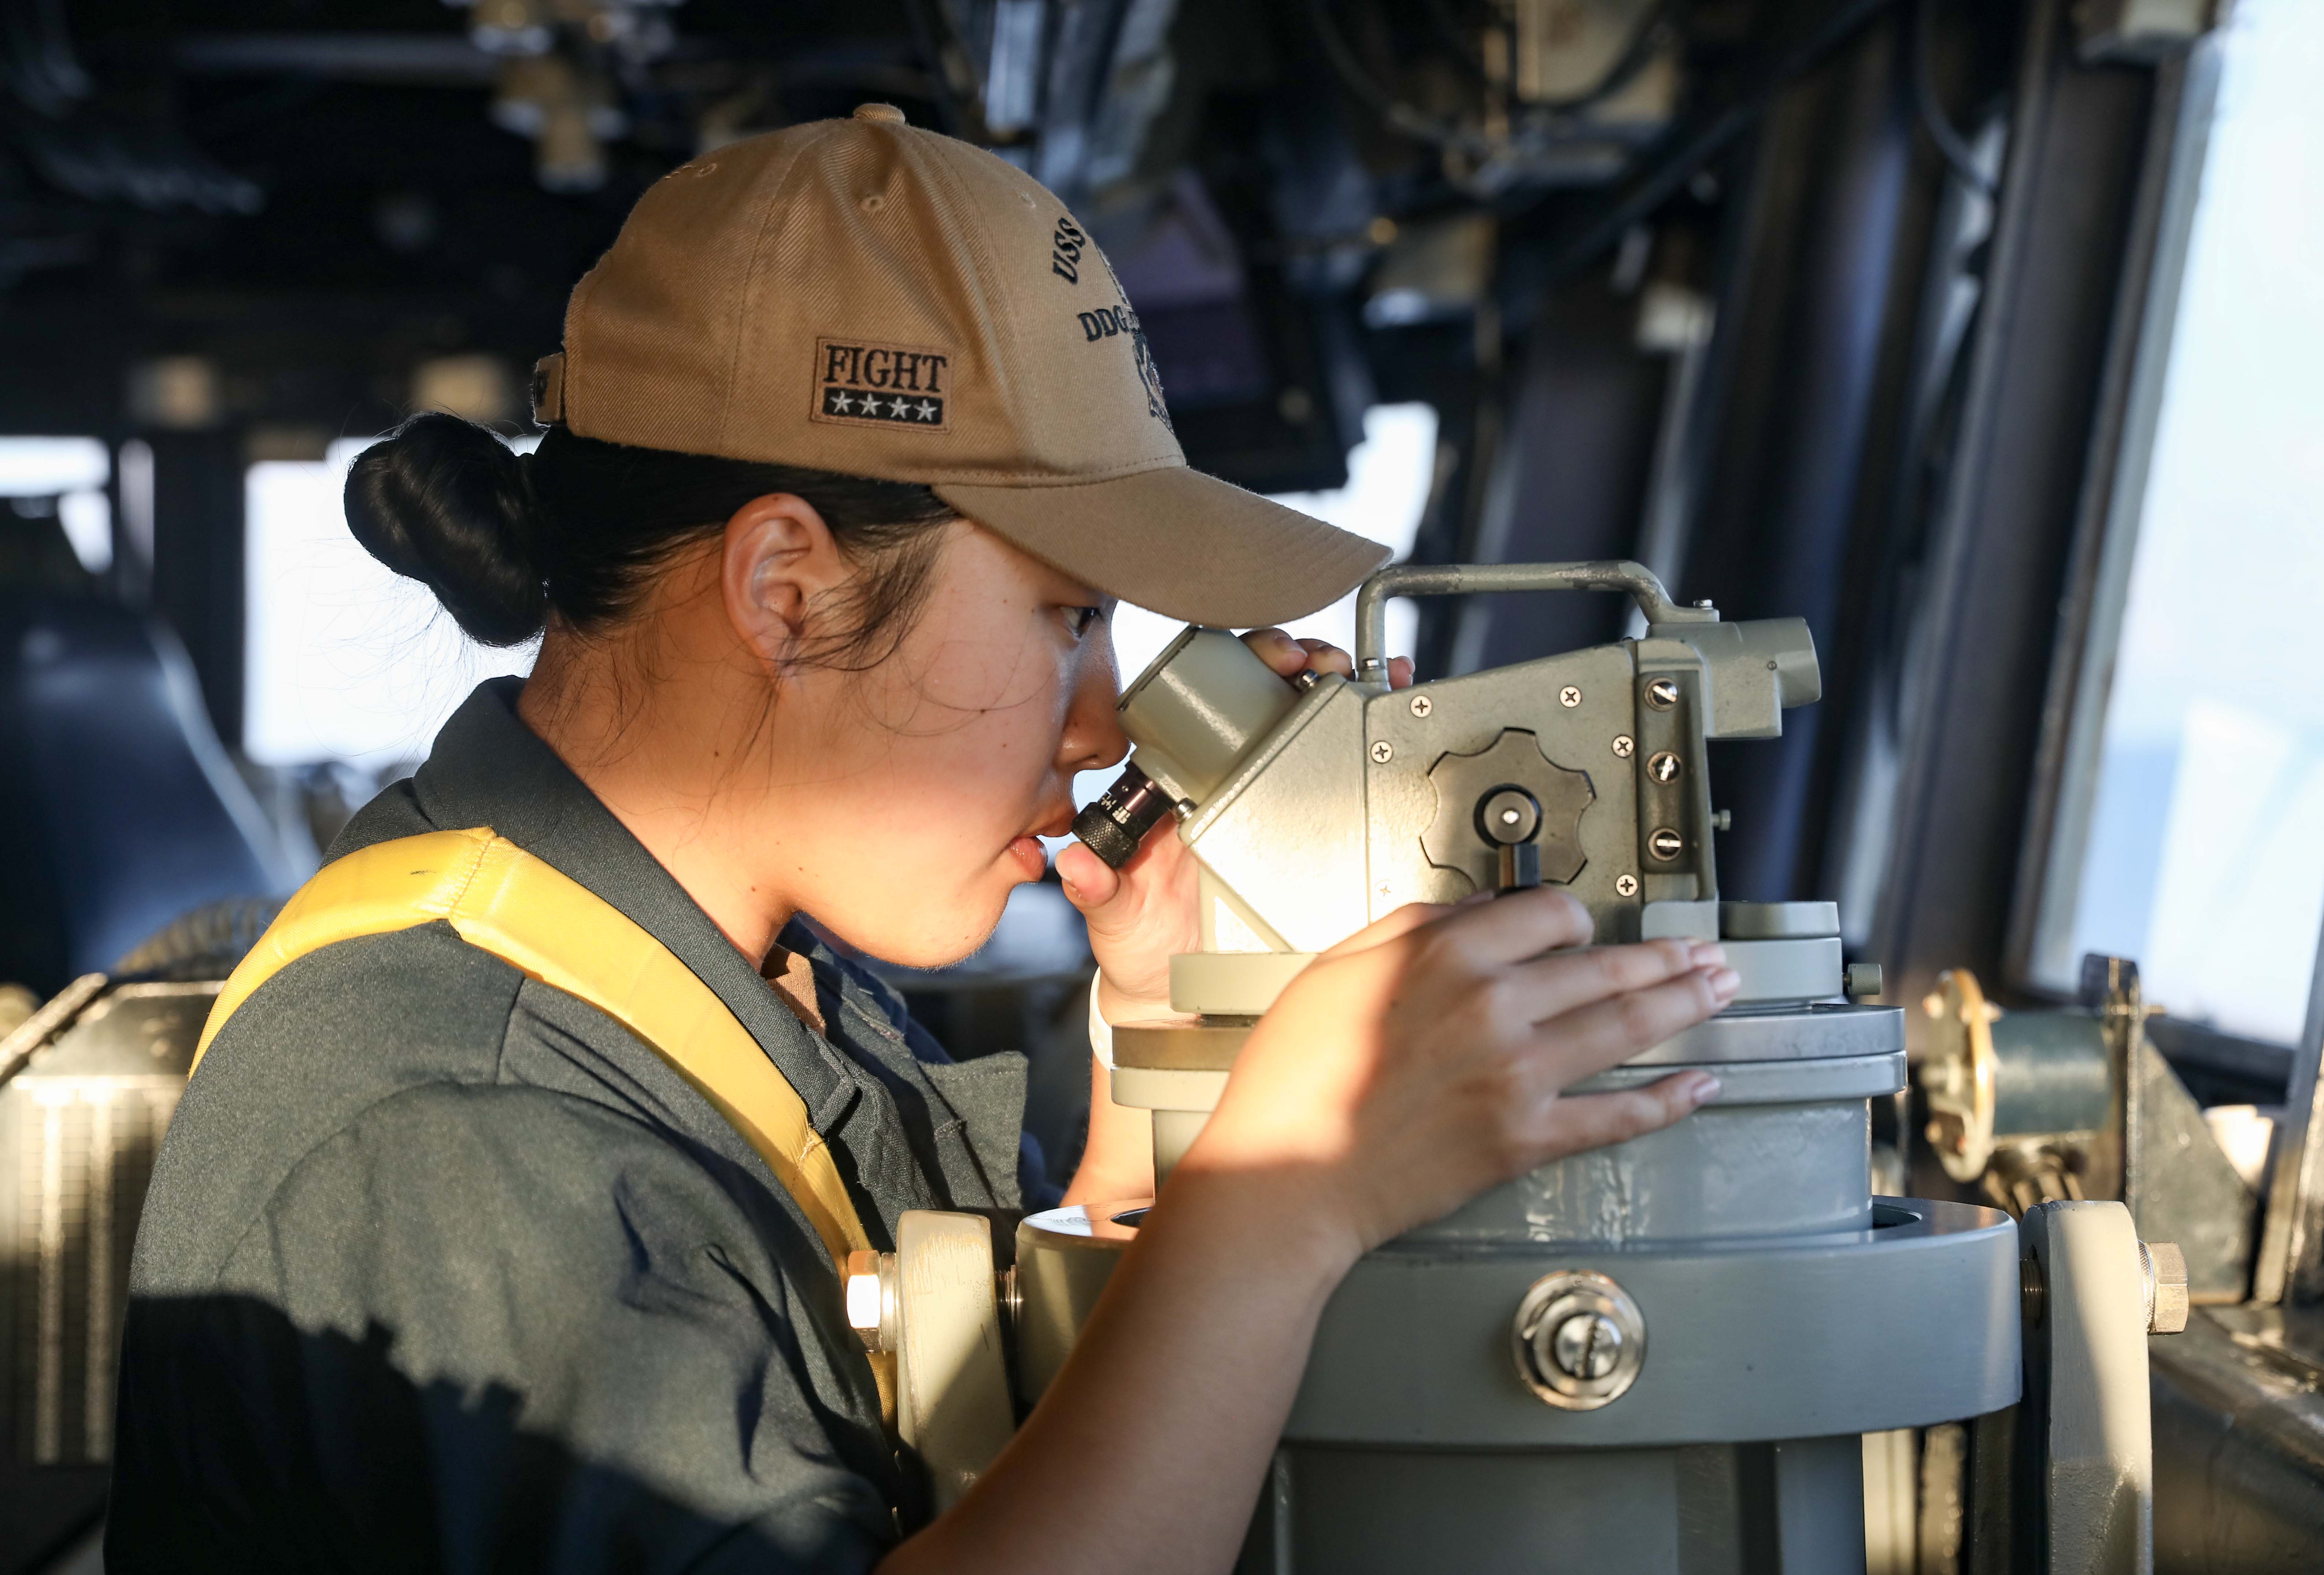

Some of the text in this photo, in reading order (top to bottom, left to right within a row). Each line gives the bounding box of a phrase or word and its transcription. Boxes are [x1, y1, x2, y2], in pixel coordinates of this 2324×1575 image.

[1052, 218, 1085, 285] USS
[1077, 305, 1129, 342] DDG
[823, 344, 947, 392] FIGHT
